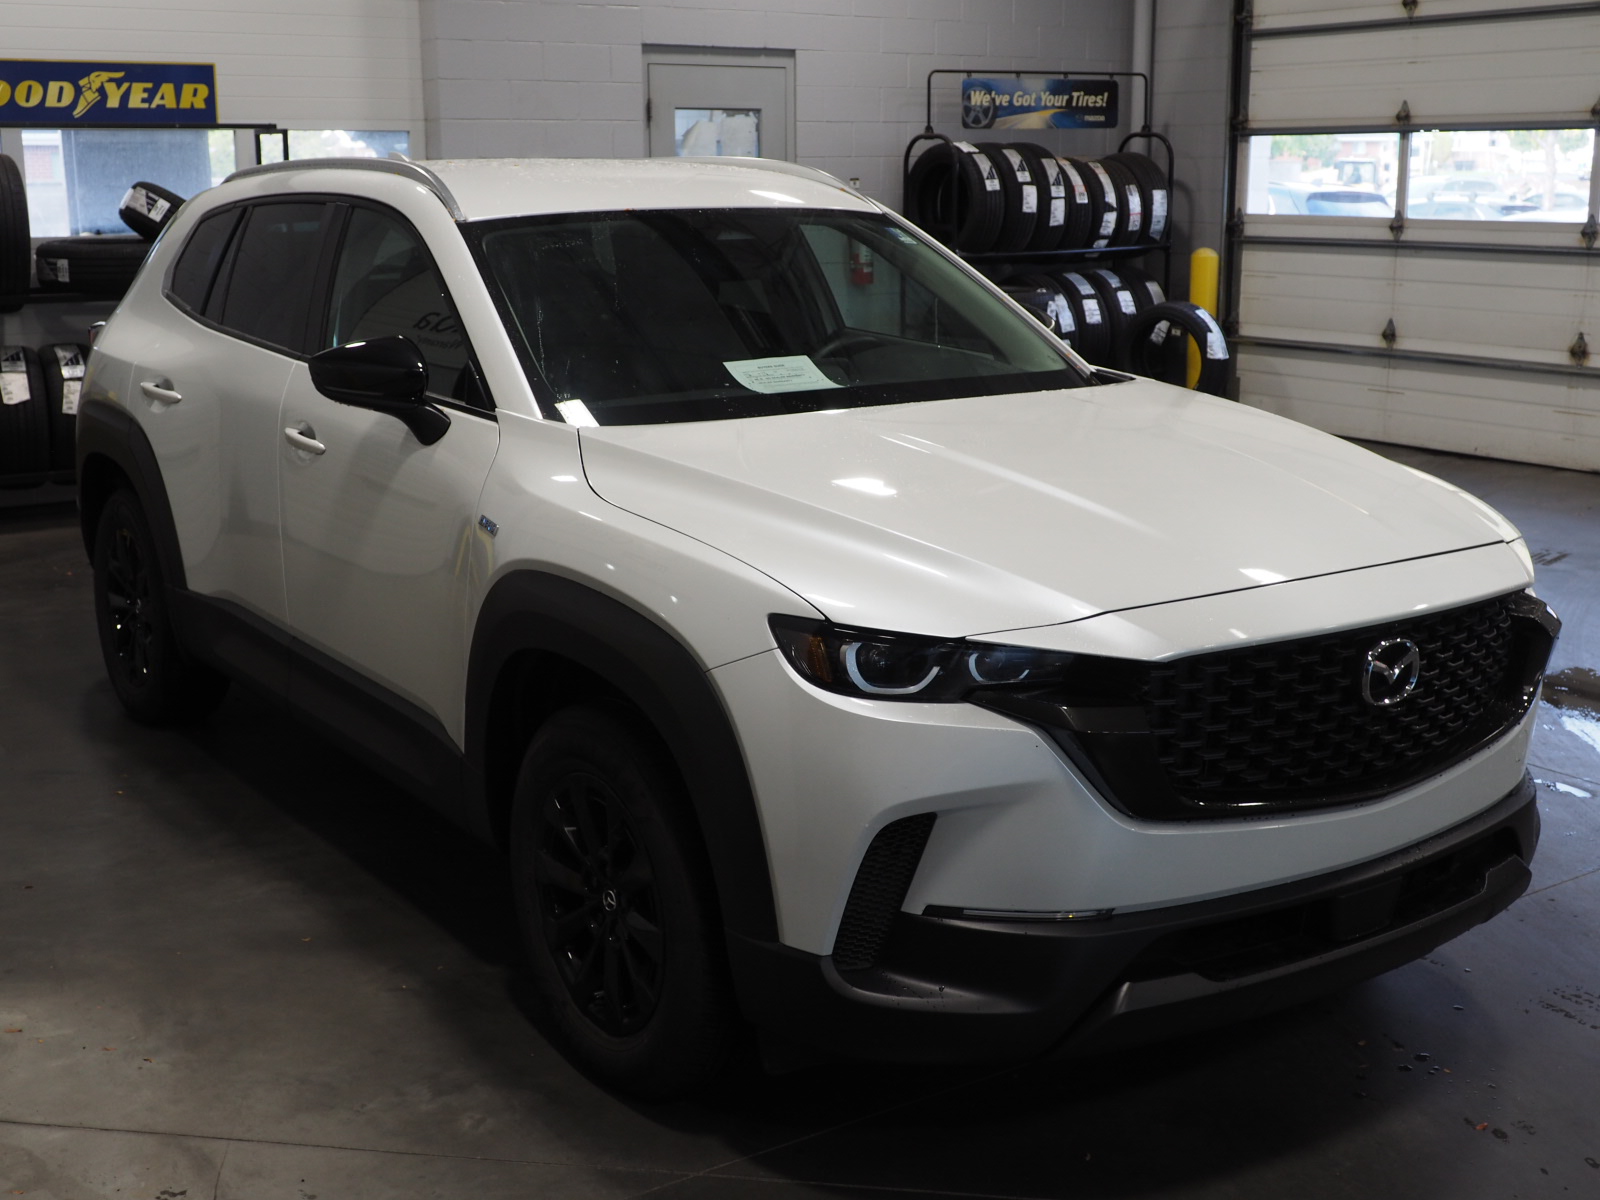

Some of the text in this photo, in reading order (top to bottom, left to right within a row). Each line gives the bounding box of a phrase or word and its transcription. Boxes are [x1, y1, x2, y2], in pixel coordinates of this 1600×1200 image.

[970, 90, 1108, 107] We've Got Your Tires!
